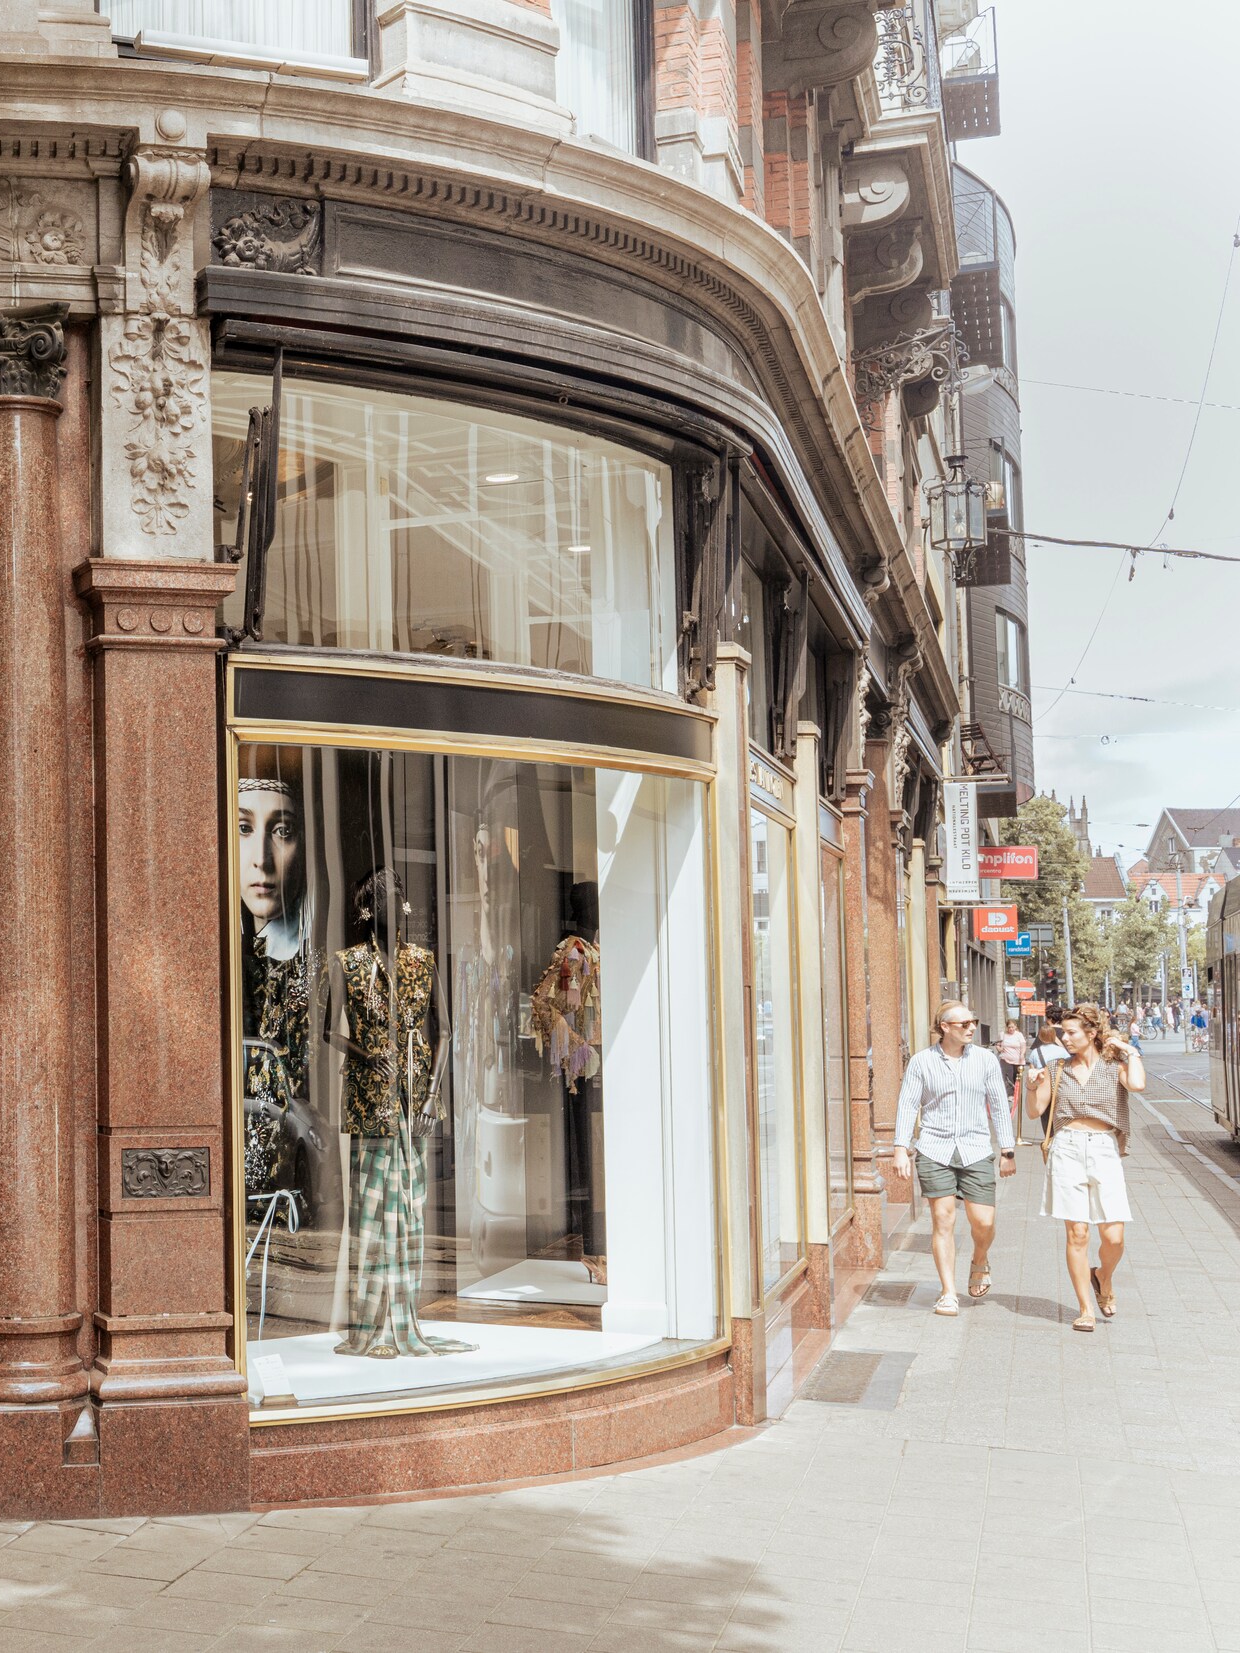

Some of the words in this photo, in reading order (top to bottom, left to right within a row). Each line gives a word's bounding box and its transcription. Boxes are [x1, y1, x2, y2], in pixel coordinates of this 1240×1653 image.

[959, 783, 970, 825] MELTING
[961, 827, 971, 846] POT
[961, 849, 971, 870] KILO
[979, 852, 1033, 867] mplifon
